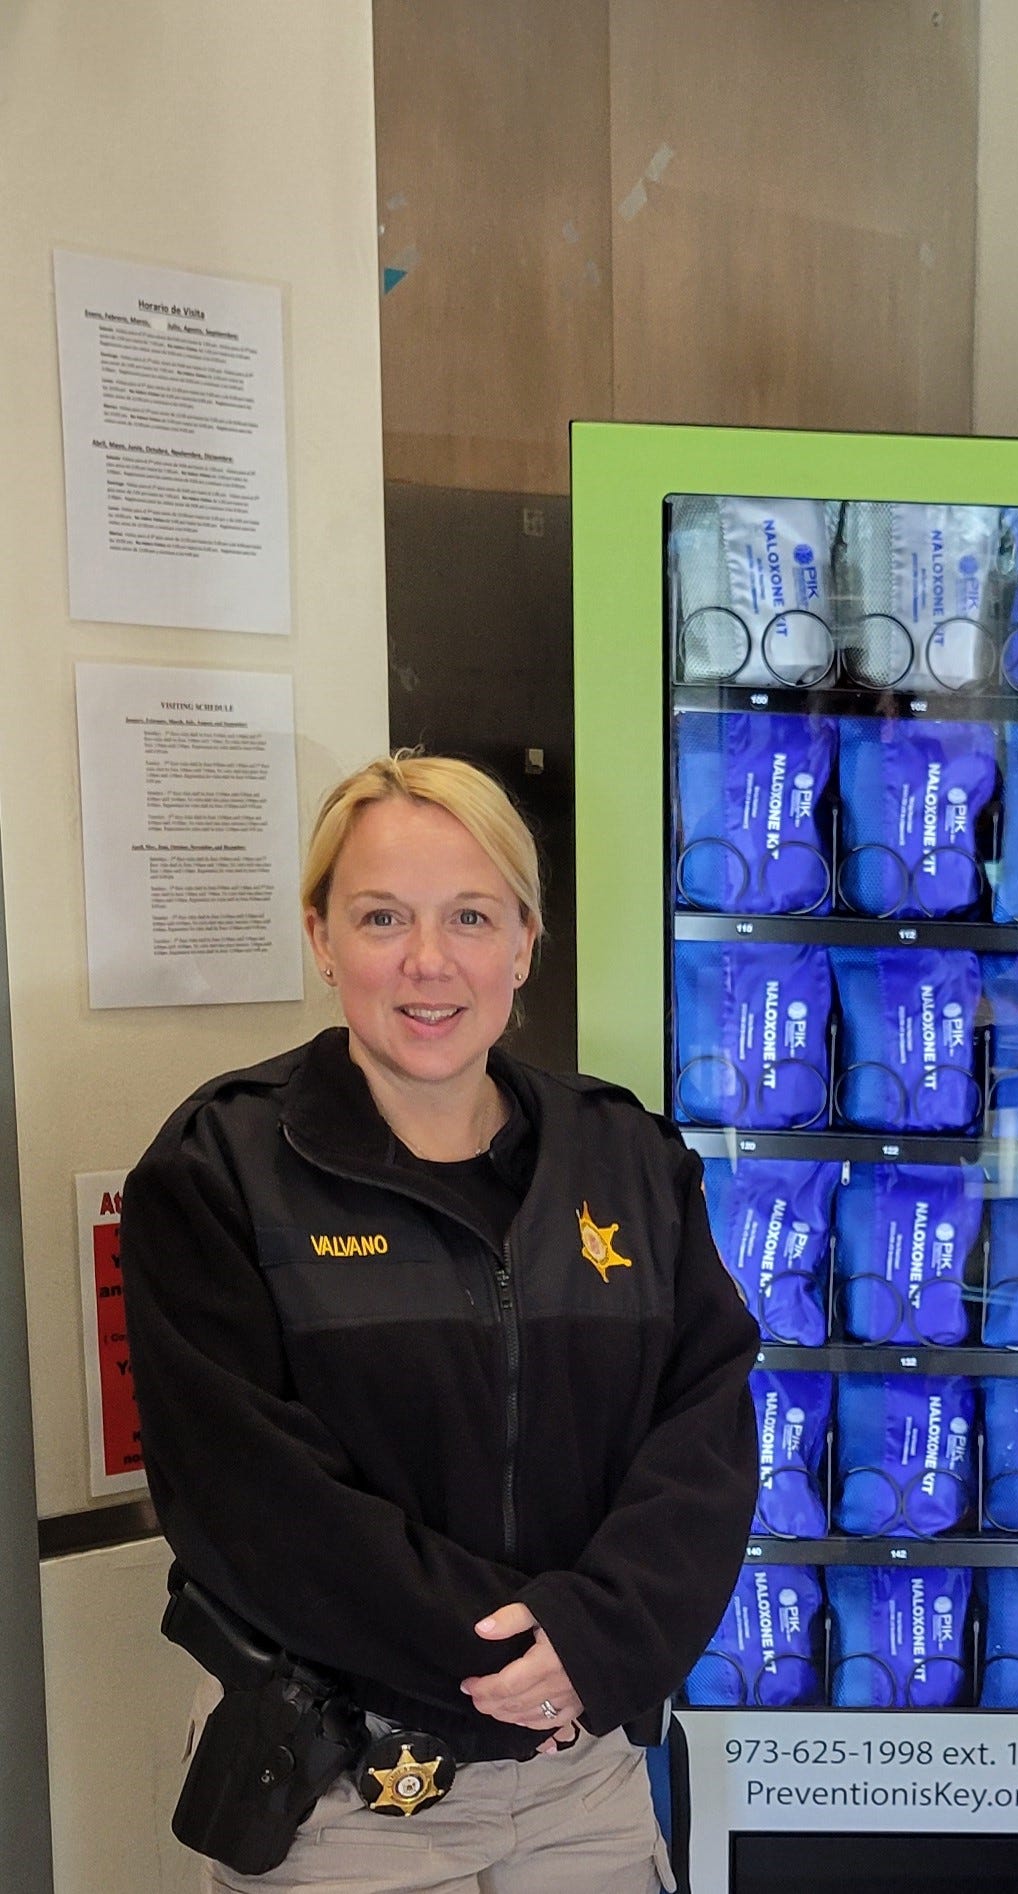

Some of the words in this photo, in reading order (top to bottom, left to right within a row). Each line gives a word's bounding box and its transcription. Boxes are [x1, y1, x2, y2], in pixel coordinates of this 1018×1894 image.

[138, 299, 169, 314] Horario
[171, 305, 182, 315] de
[184, 307, 205, 319] Visita
[763, 519, 785, 607] NALOXONE
[931, 530, 945, 616] NALOXONE
[806, 566, 820, 600] PIK
[160, 702, 194, 711] VISITING
[195, 703, 234, 712] SCHEDULE
[910, 702, 928, 712] 102
[767, 753, 787, 831] NALOXONE
[800, 790, 813, 817] PIK
[923, 763, 941, 848] NALOXONE
[954, 805, 968, 833] PIK
[899, 929, 917, 940] 112
[763, 981, 779, 1061] NALOXONE
[794, 1021, 806, 1048] PIK
[921, 985, 936, 1063] NALOXONE
[951, 1018, 964, 1047] PIK
[310, 1234, 388, 1257] VALVANO
[760, 1199, 787, 1271] NALOXONE
[909, 1202, 928, 1282] NALOXONE
[940, 1243, 954, 1270] PIK
[761, 1392, 778, 1465] NALOXONE
[791, 1425, 804, 1452] PIK
[925, 1396, 942, 1469] NALOXONE
[953, 1435, 967, 1463] PIK
[921, 1471, 937, 1496] KIT
[746, 1547, 762, 1556] 140
[890, 1550, 907, 1559] 142
[754, 1572, 774, 1648] NALOXONE
[788, 1606, 801, 1632] PIK
[911, 1578, 925, 1655] NALOXONE
[940, 1614, 953, 1640] PIK
[725, 1739, 933, 1764] 973-625-1998
[942, 1742, 996, 1766] ext.
